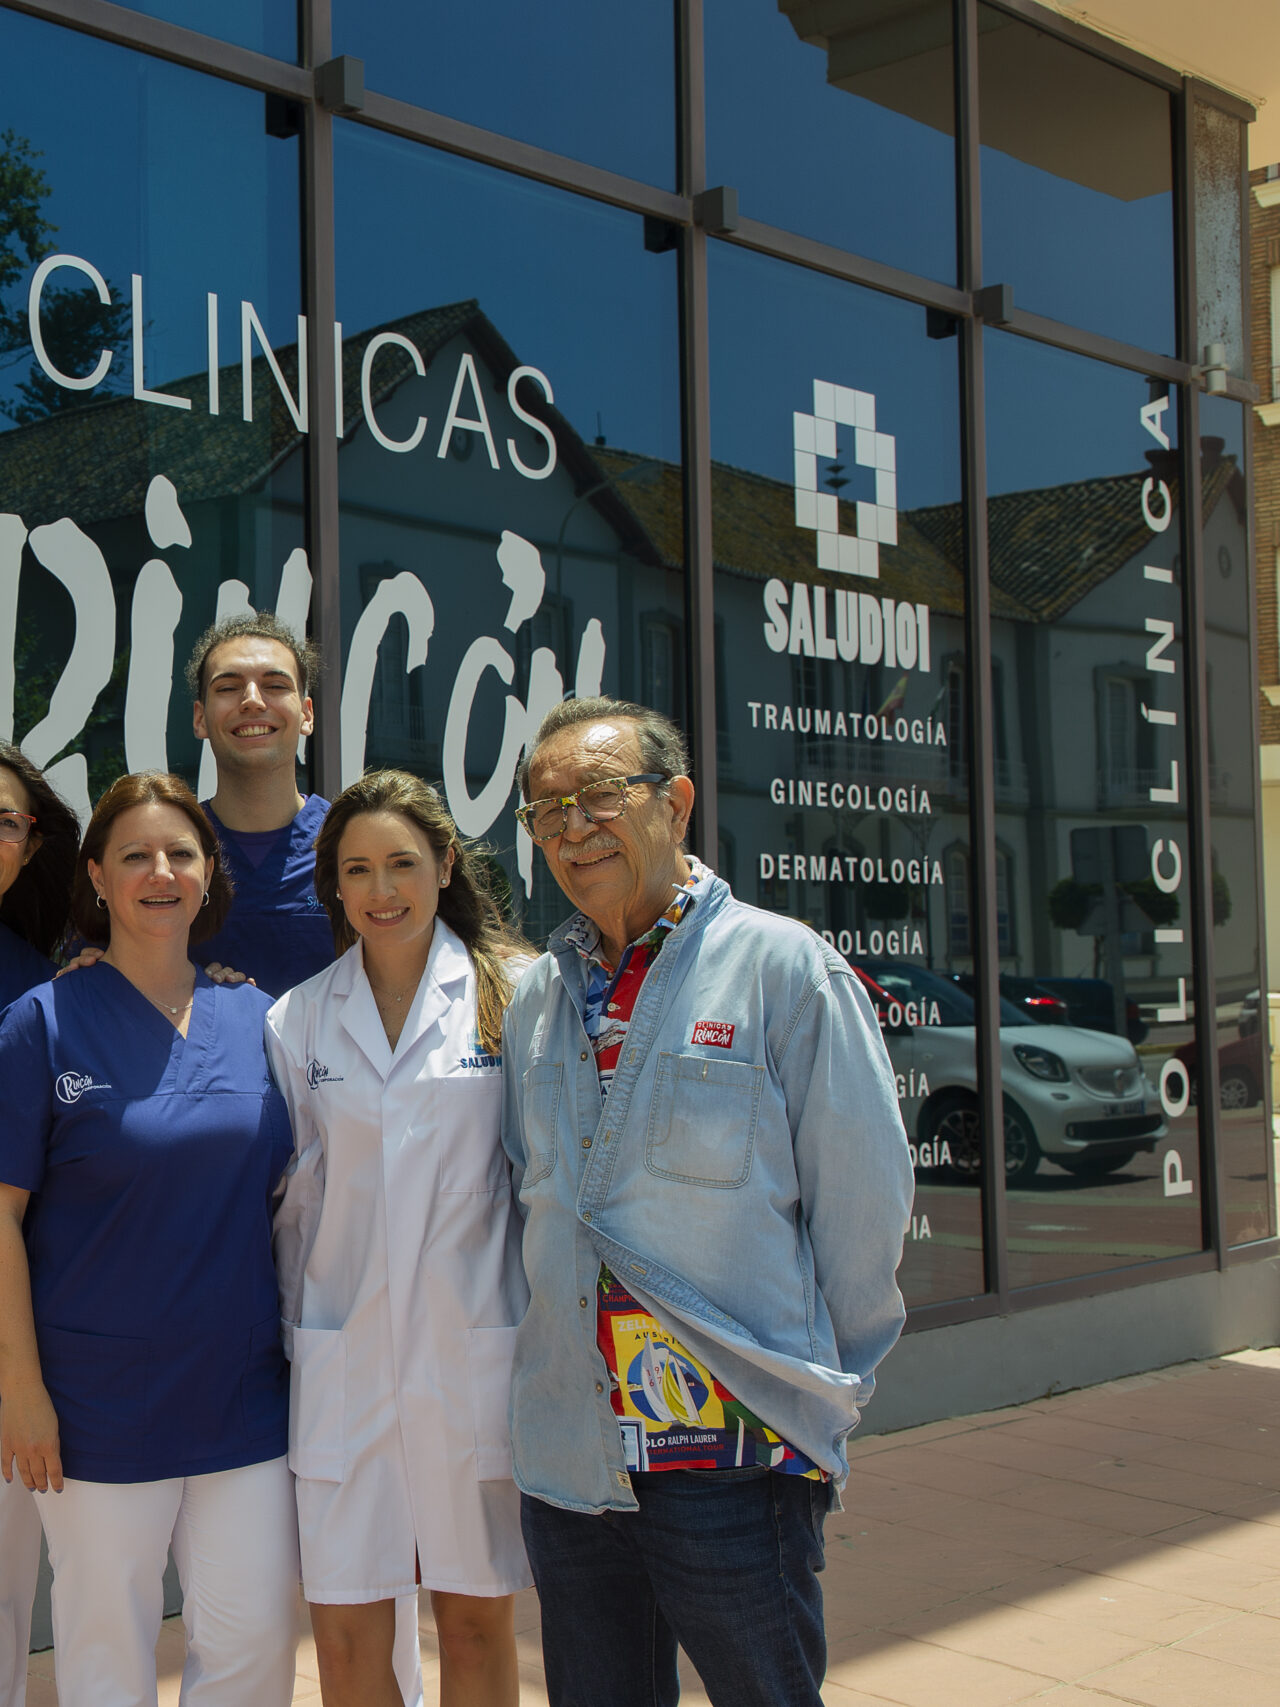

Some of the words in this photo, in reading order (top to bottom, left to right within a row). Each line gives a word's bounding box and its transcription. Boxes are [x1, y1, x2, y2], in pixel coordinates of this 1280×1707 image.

[29, 254, 557, 480] CLINICAS
[763, 578, 932, 673] SALUD101
[747, 701, 948, 746] TRAUMATOLOGÍA
[770, 778, 932, 815] GINECOLOGÍA
[1141, 396, 1193, 1197] POLICLÍNICA
[760, 853, 944, 886] DERMATOLOGÍA
[645, 1437, 666, 1448] OLO
[667, 1434, 689, 1446] RALPH
[690, 1434, 717, 1444] LAUREN
